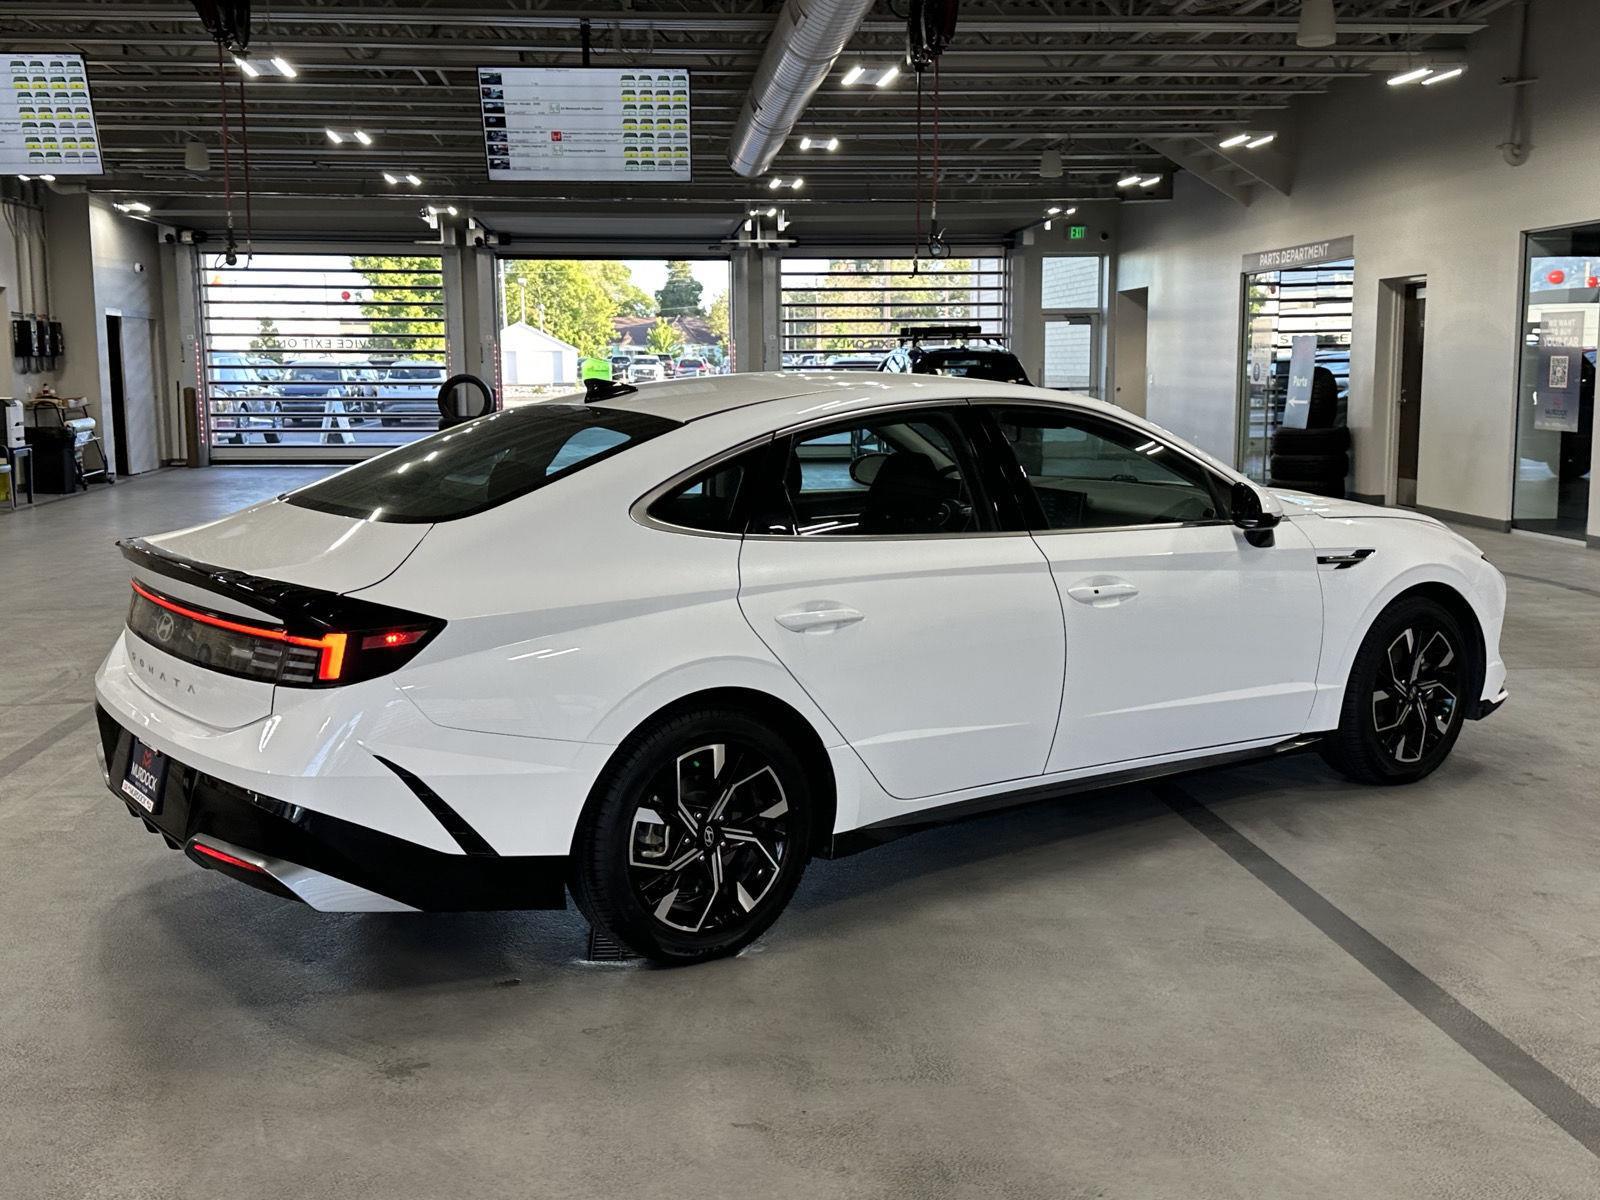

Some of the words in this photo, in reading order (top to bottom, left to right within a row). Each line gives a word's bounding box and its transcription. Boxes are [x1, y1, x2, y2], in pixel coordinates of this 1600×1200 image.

[1259, 251, 1281, 266] PARTS
[1281, 243, 1329, 263] DEPARTMENT
[1292, 375, 1308, 388] Parts
[131, 651, 196, 695] SONATA
[130, 761, 158, 792] MURDOCK
